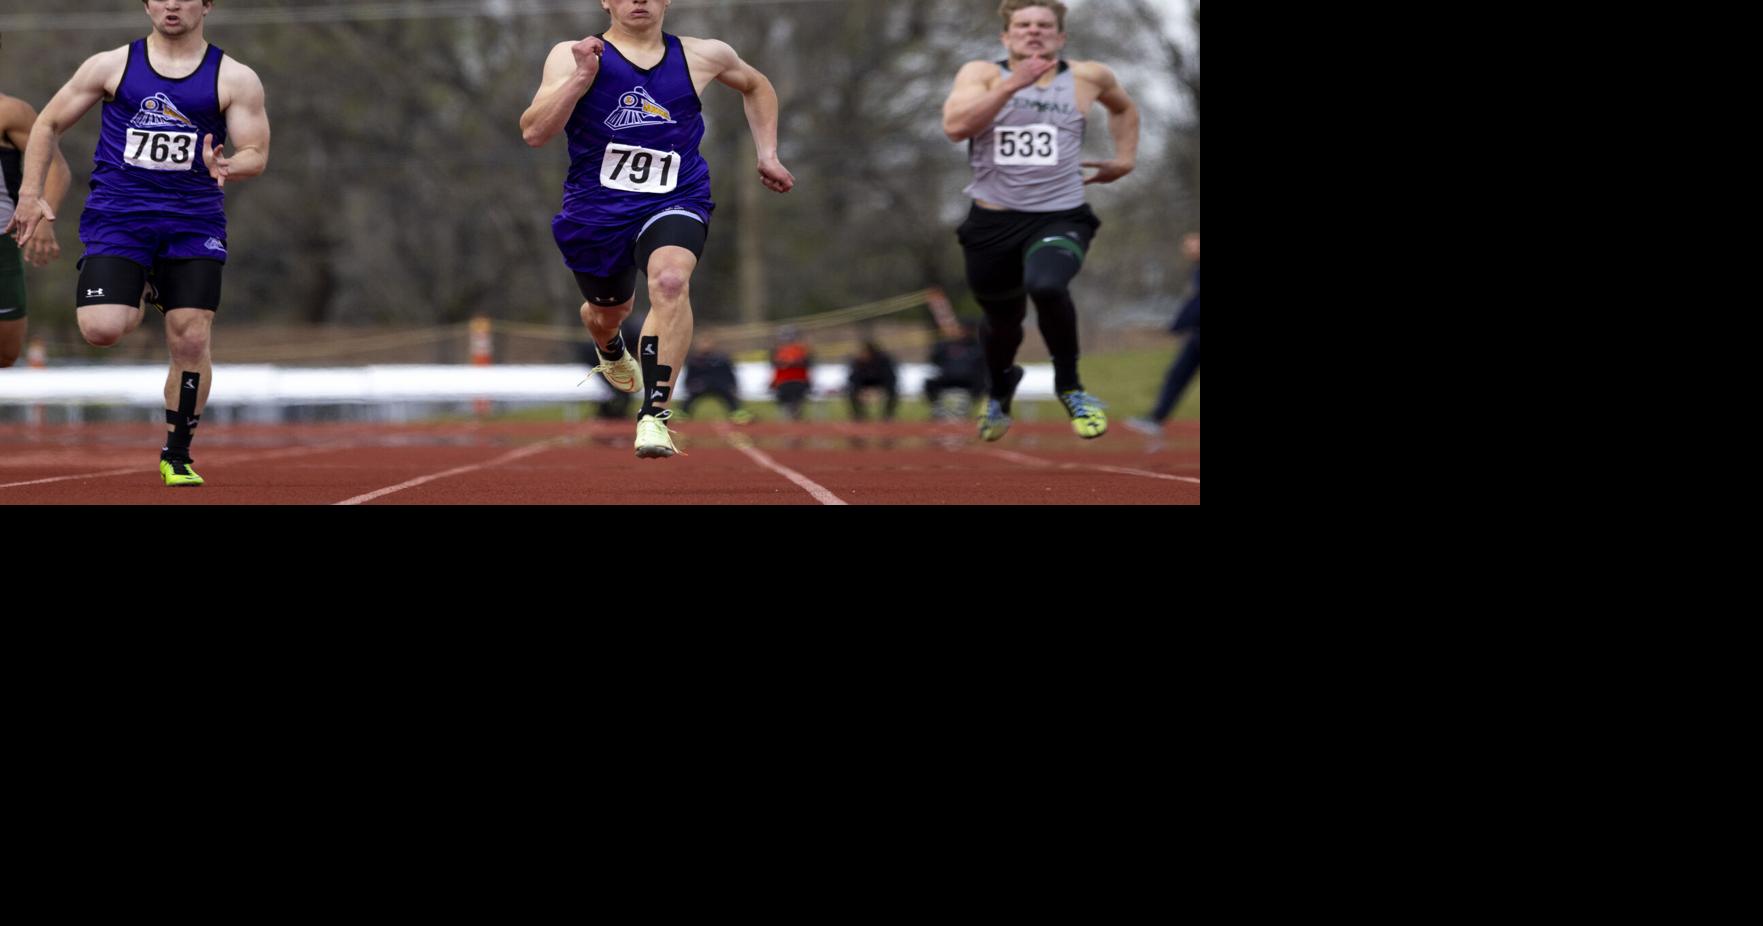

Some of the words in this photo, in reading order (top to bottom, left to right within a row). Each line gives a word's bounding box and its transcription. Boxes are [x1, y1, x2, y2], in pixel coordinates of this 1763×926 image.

[131, 131, 191, 163] 763
[1000, 131, 1052, 157] 533
[609, 149, 673, 186] 791
